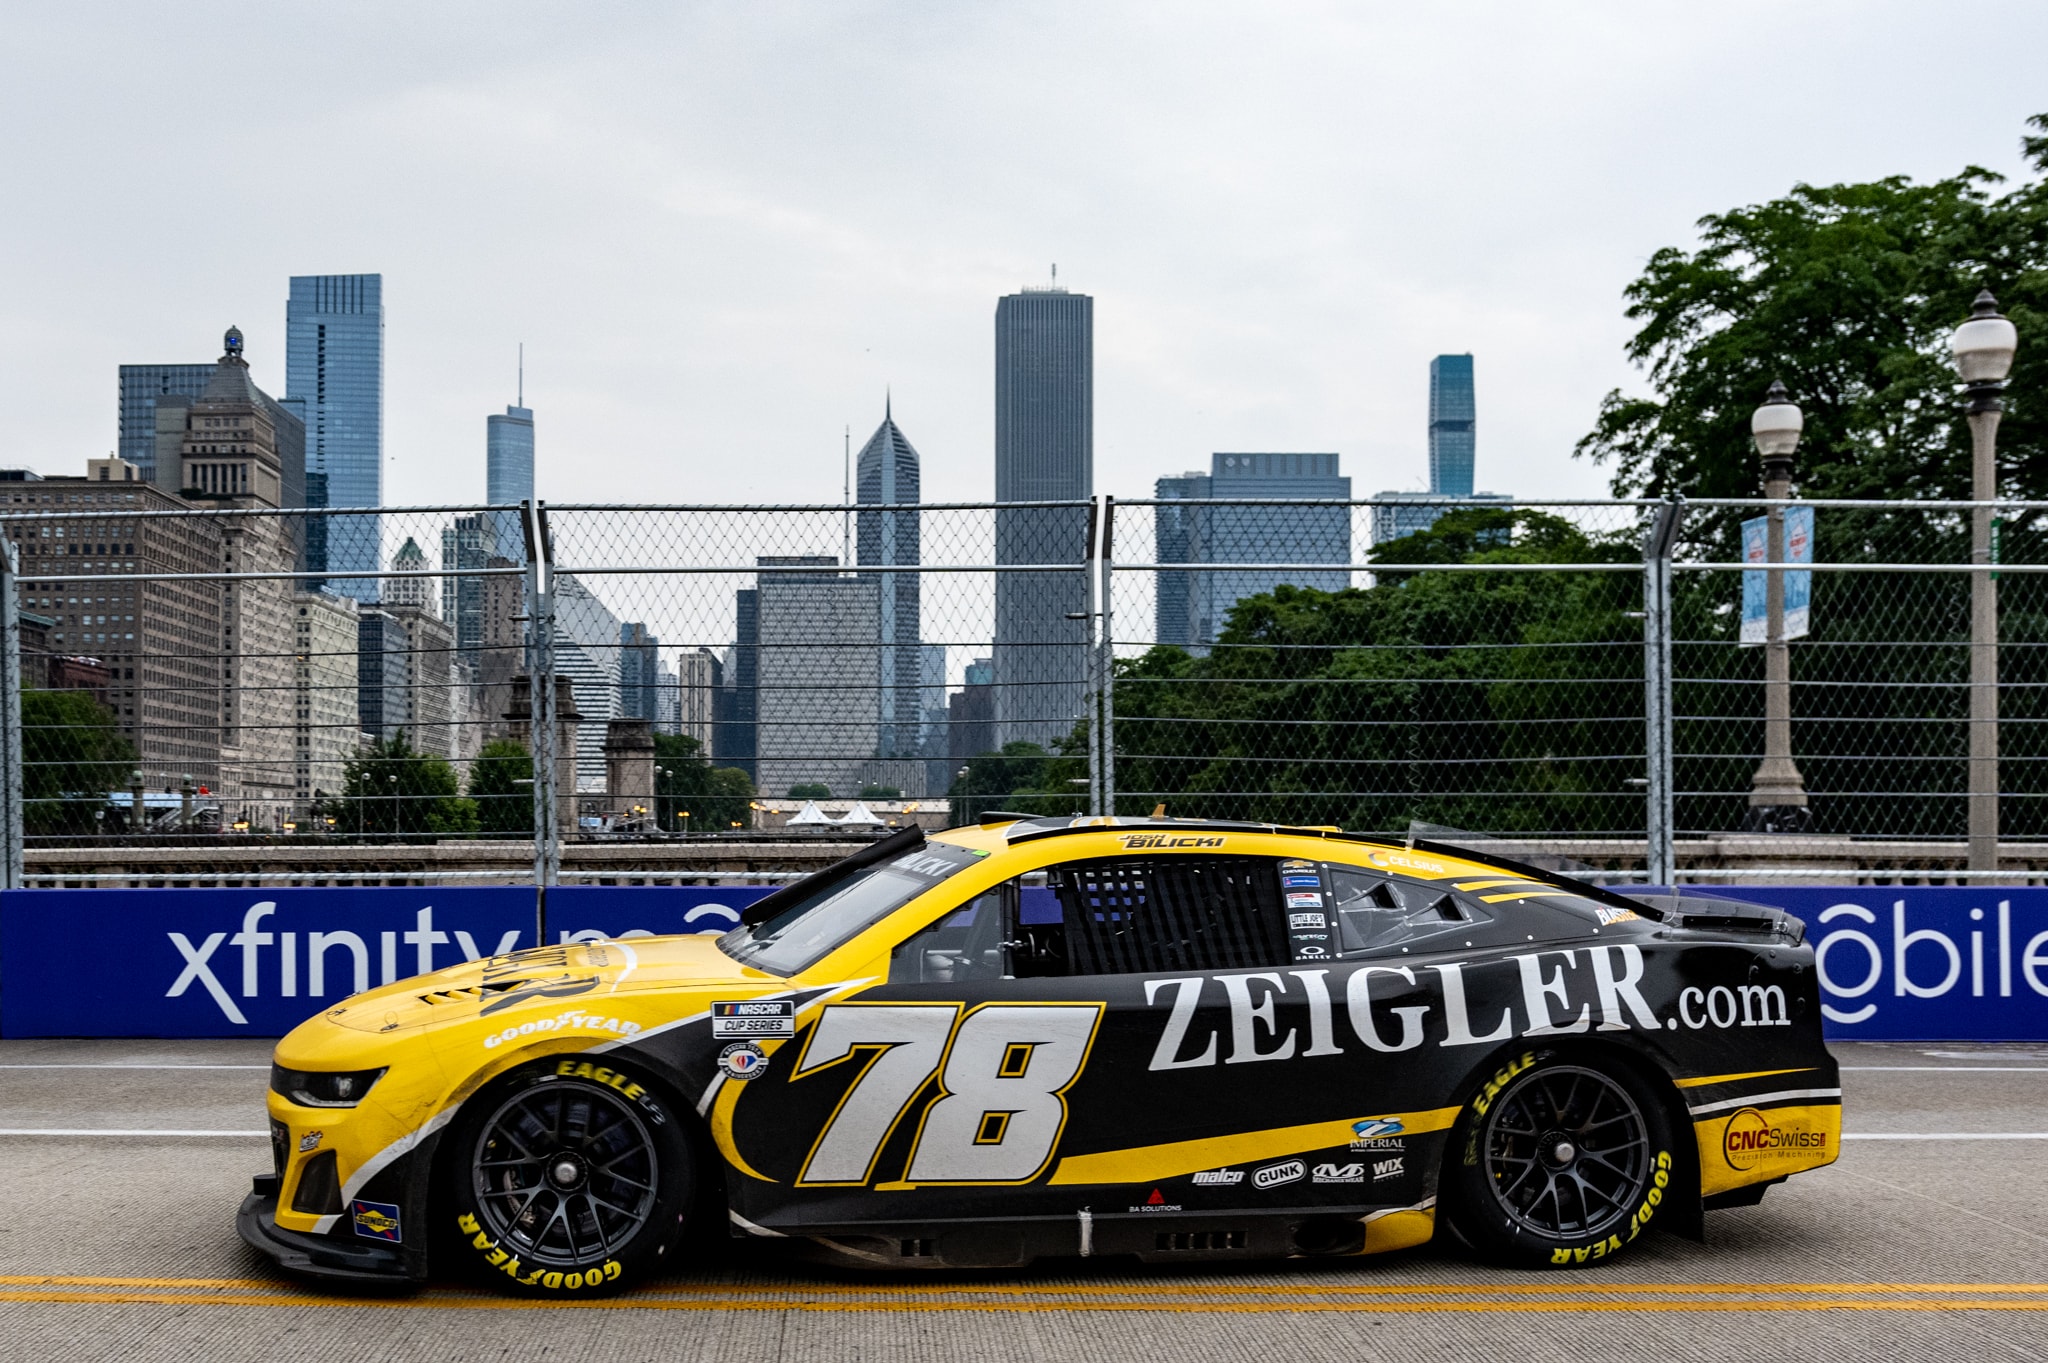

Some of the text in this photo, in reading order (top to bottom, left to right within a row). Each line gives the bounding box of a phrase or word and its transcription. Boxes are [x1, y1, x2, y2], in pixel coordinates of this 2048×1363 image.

[1125, 837, 1224, 849] BILICKI
[1389, 855, 1445, 874] CELSIUS
[738, 1003, 783, 1015] NASCAR
[1144, 943, 1792, 1072] ZEIGLER.com
[483, 1010, 642, 1049] GOODYEAR
[724, 1020, 784, 1031] CUP SERIES
[555, 1060, 647, 1102] EAGLE
[1472, 1051, 1537, 1118] EAGLE
[789, 1003, 1106, 1188] 78
[1349, 1138, 1406, 1149] IMPERIAL
[1731, 1150, 1826, 1161] Precision Machining
[1192, 1168, 1247, 1184] malco
[1257, 1164, 1301, 1185] GUNK
[1372, 1157, 1405, 1176] WIX
[357, 1213, 399, 1229] SUNOCO
